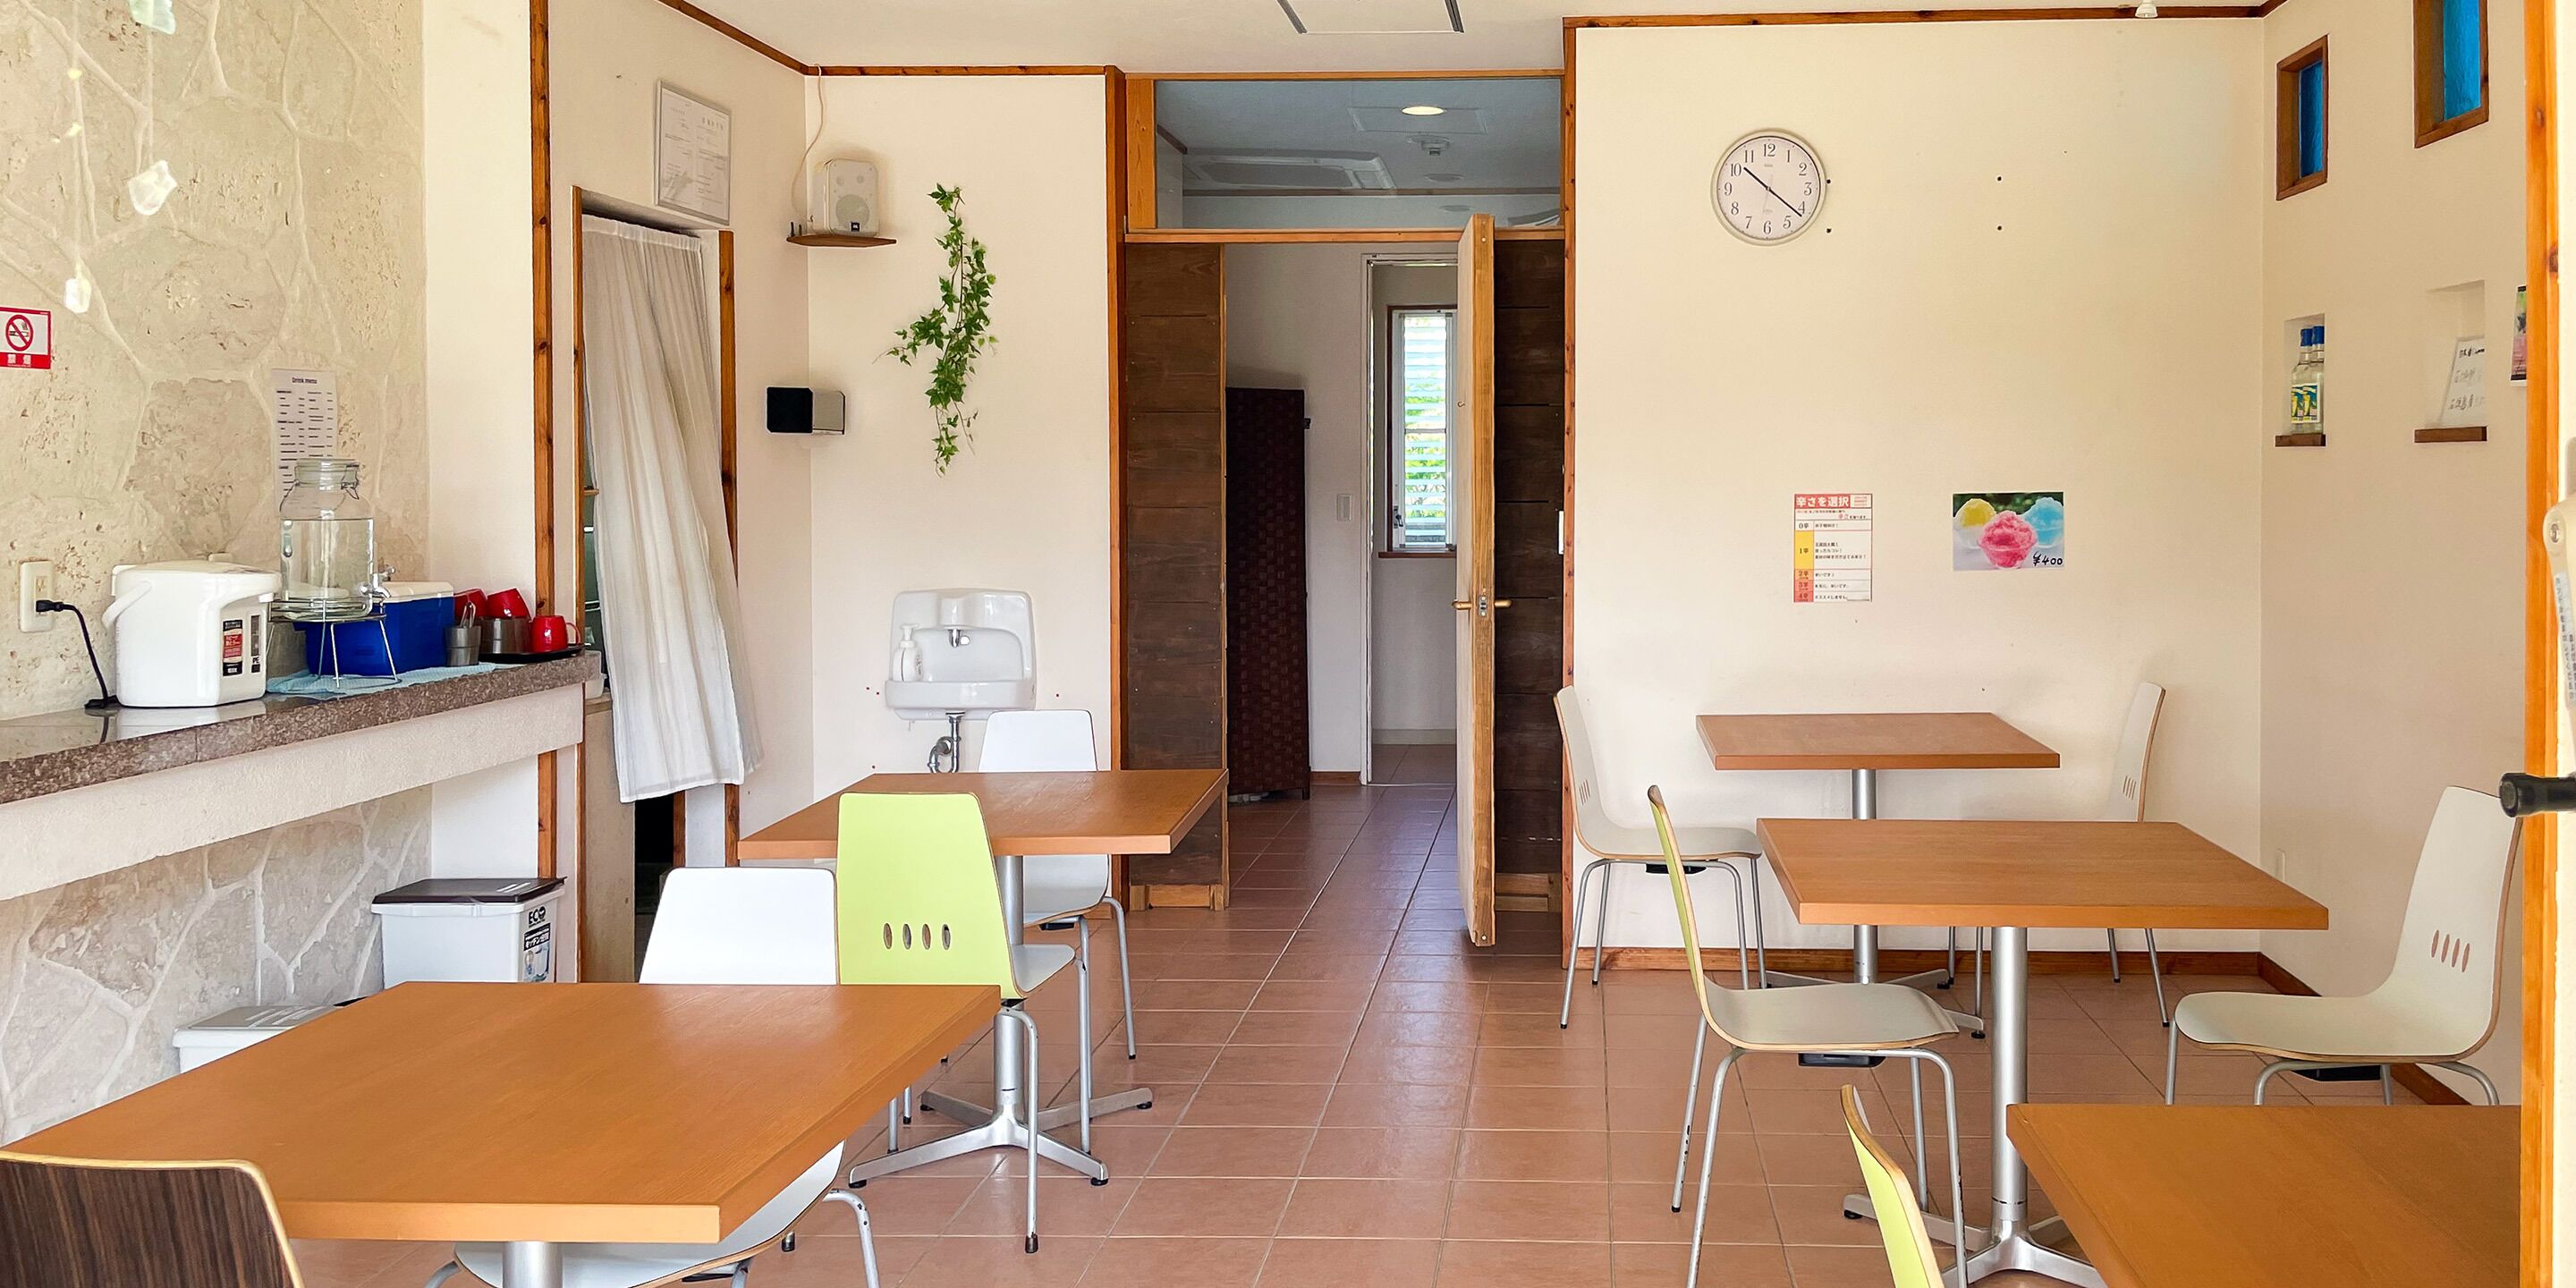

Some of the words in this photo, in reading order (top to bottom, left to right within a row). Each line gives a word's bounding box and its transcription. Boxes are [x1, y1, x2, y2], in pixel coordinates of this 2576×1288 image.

[1744, 149, 1754, 163] 11
[1763, 143, 1776, 157] 12
[1787, 149, 1791, 163] 1
[1730, 163, 1742, 177] 10
[1798, 163, 1807, 176] 2
[1724, 182, 1733, 196] 9
[1803, 182, 1812, 196] 3
[1731, 201, 1740, 215] 8
[1797, 200, 1806, 215] 4
[1745, 216, 1753, 230] 7
[1763, 221, 1771, 234] 6
[1783, 216, 1792, 229] 5
[1796, 496, 1849, 507] 辛さを選択
